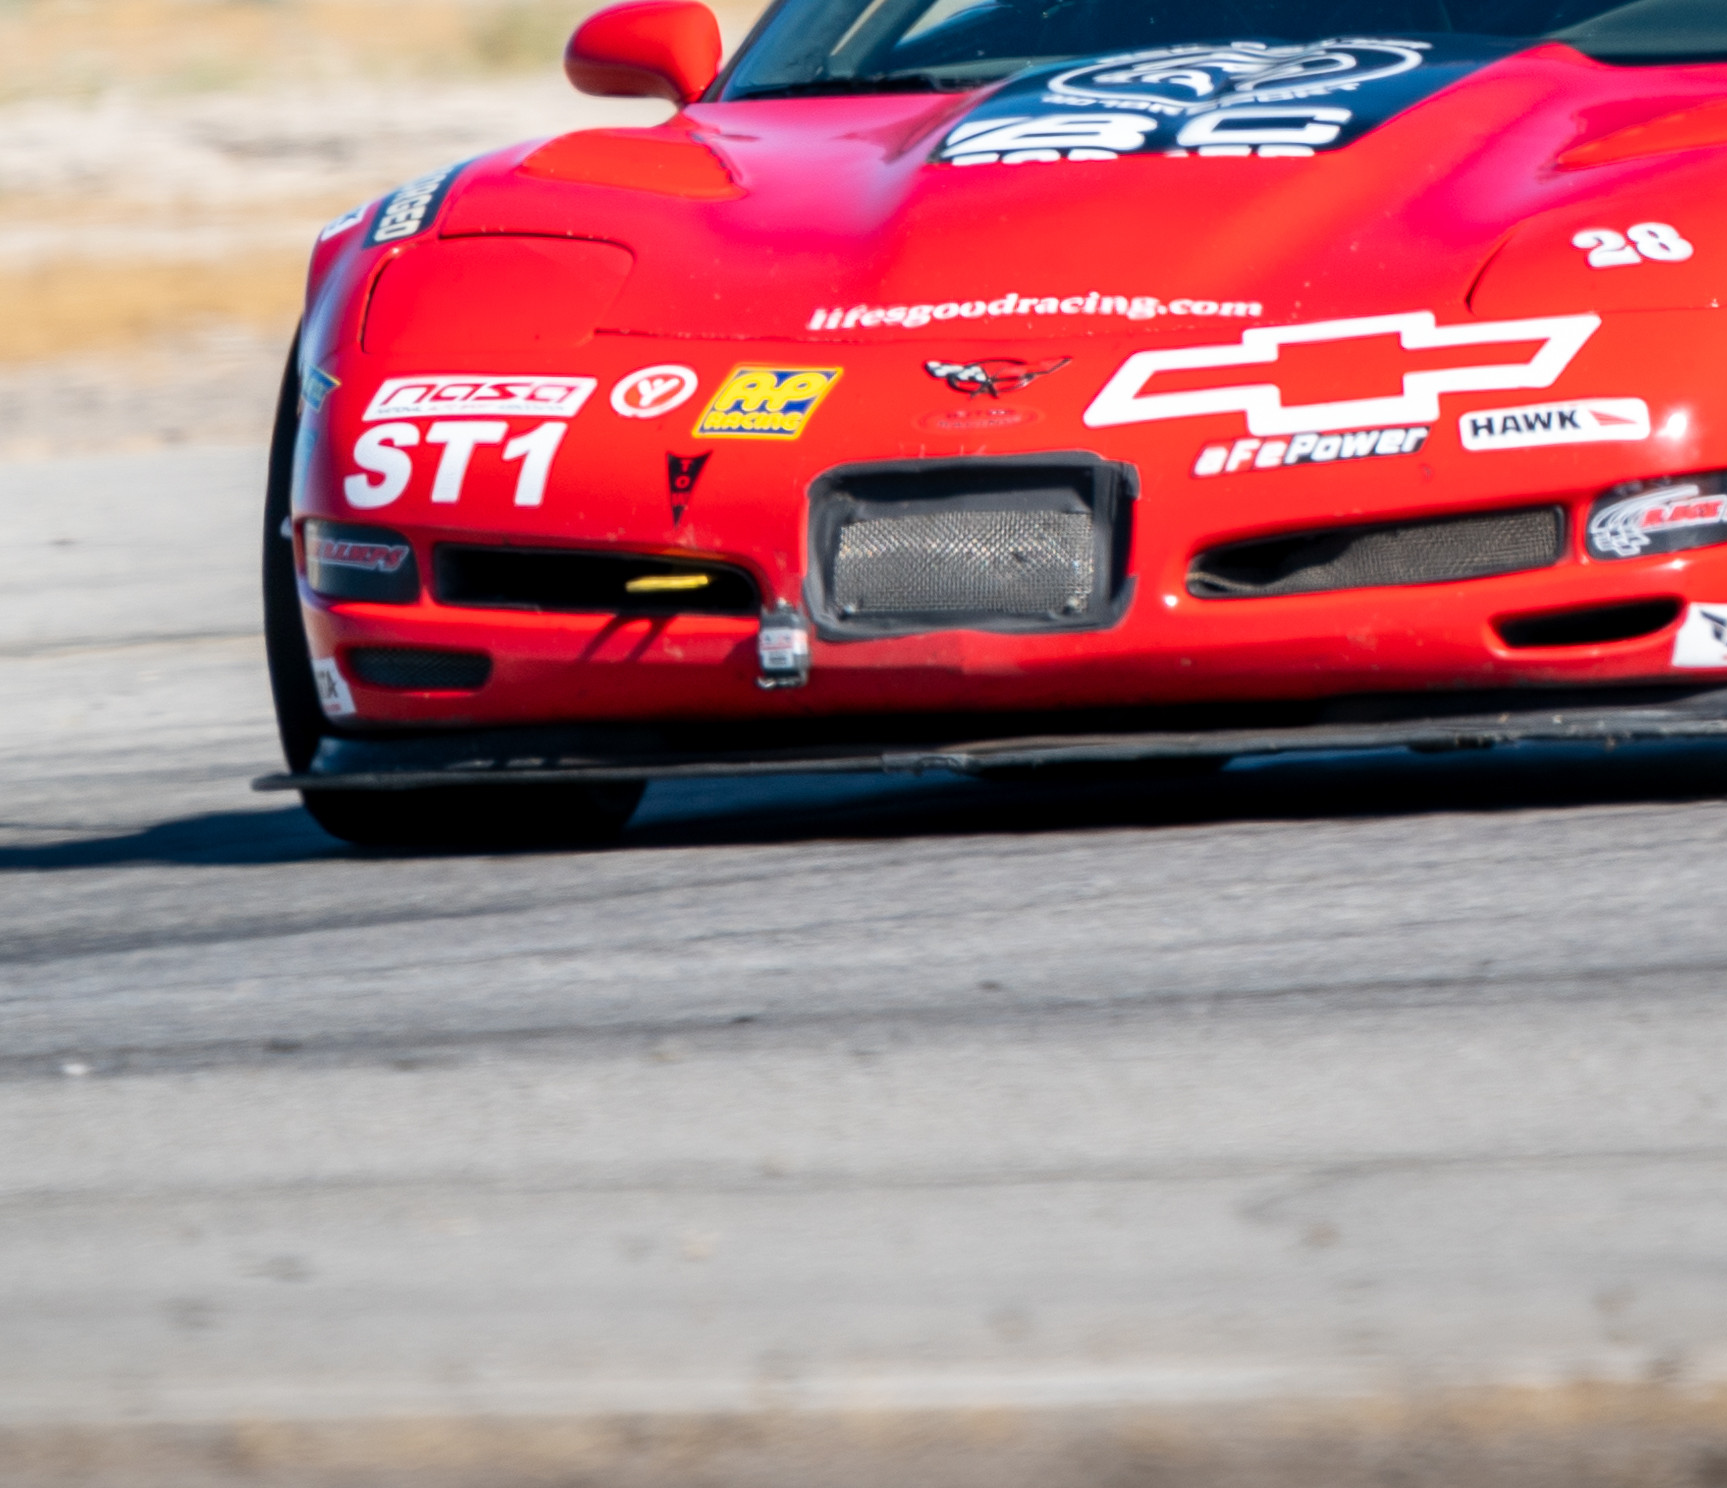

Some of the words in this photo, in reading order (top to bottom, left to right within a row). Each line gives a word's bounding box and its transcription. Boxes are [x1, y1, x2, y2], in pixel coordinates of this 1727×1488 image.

[1572, 222, 1694, 268] 28
[806, 291, 1262, 330] lifesgoodracing.com
[379, 382, 580, 407] nasa
[1470, 407, 1583, 440] HAWK
[344, 421, 568, 510] ST1
